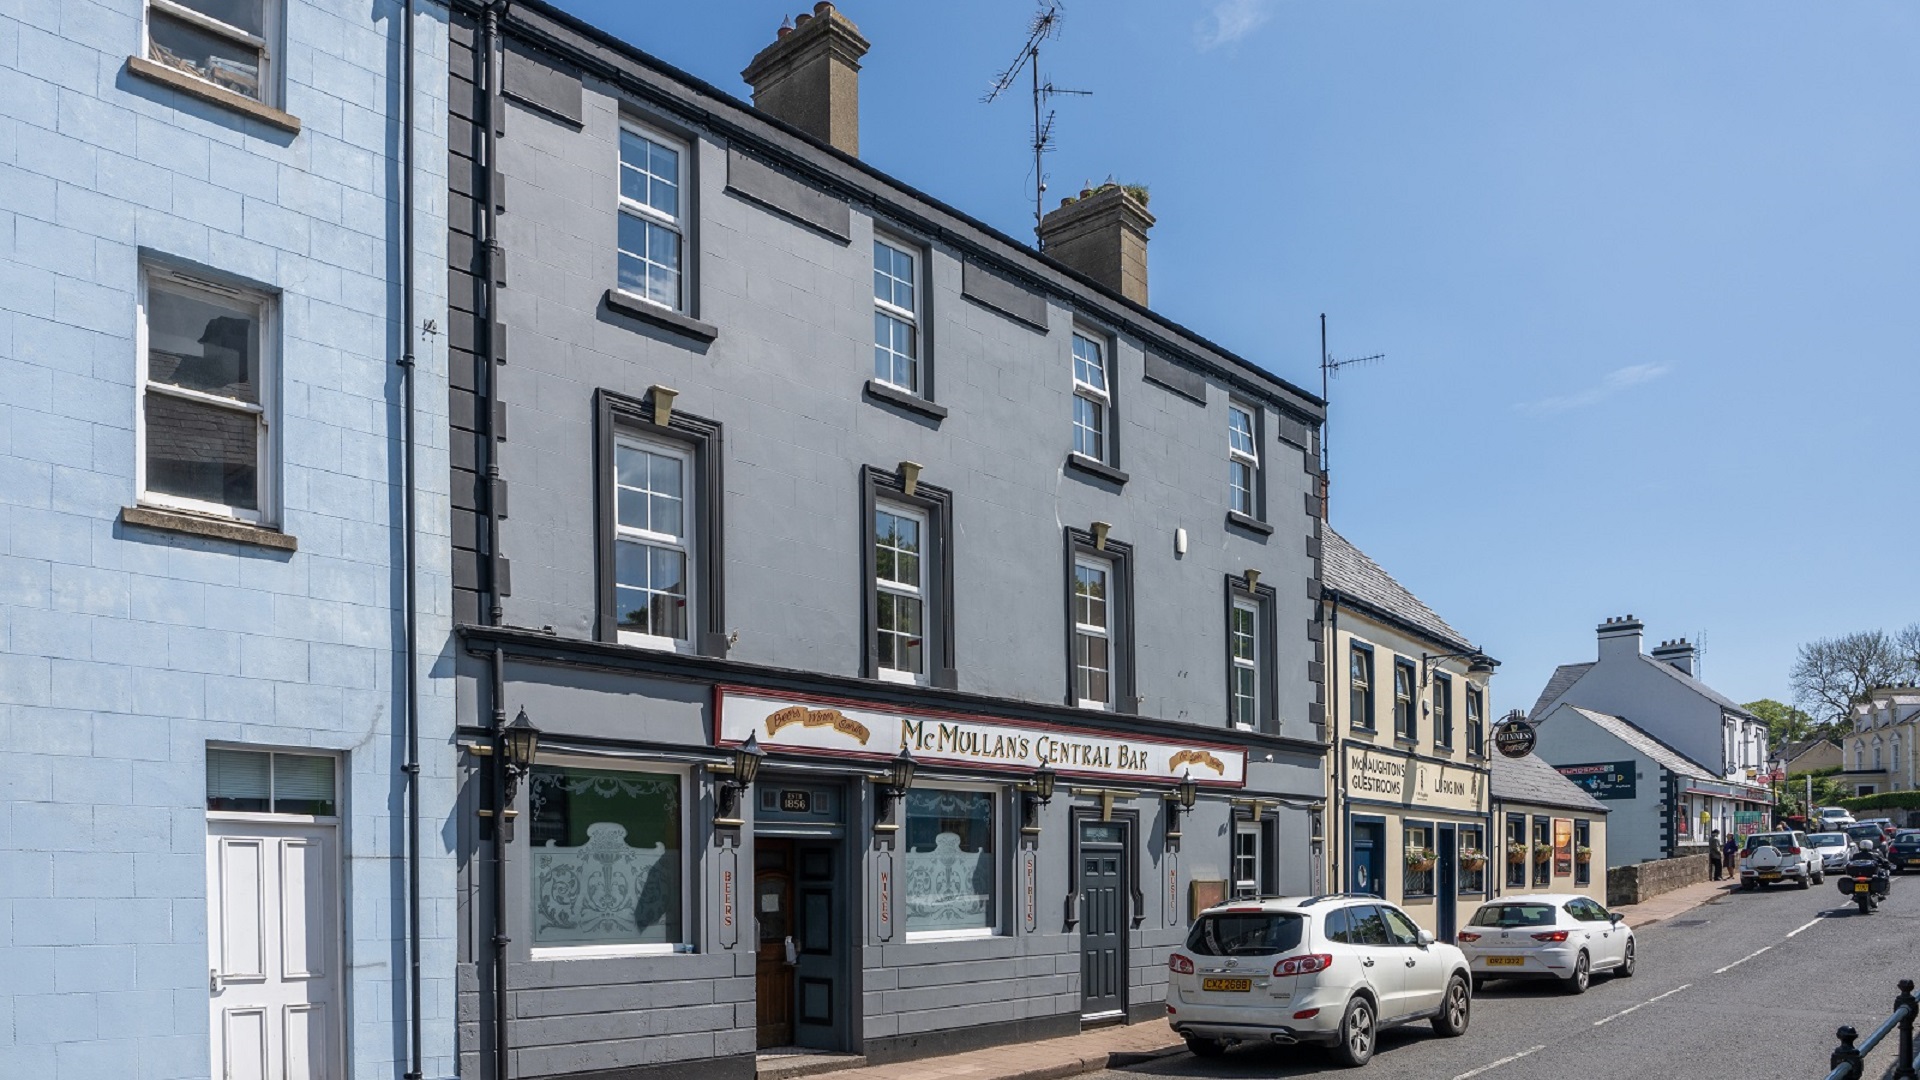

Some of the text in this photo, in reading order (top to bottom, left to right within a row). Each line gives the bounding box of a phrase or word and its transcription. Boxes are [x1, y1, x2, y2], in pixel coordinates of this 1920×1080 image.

[900, 719, 1030, 759] McMULLAN'S
[1036, 735, 1112, 768] CENTRAL
[1117, 744, 1148, 771] BAR
[1352, 774, 1401, 795] GUESTROOMS
[1454, 781, 1465, 796] INN
[785, 799, 806, 809] 1856
[724, 871, 732, 926] BEERS
